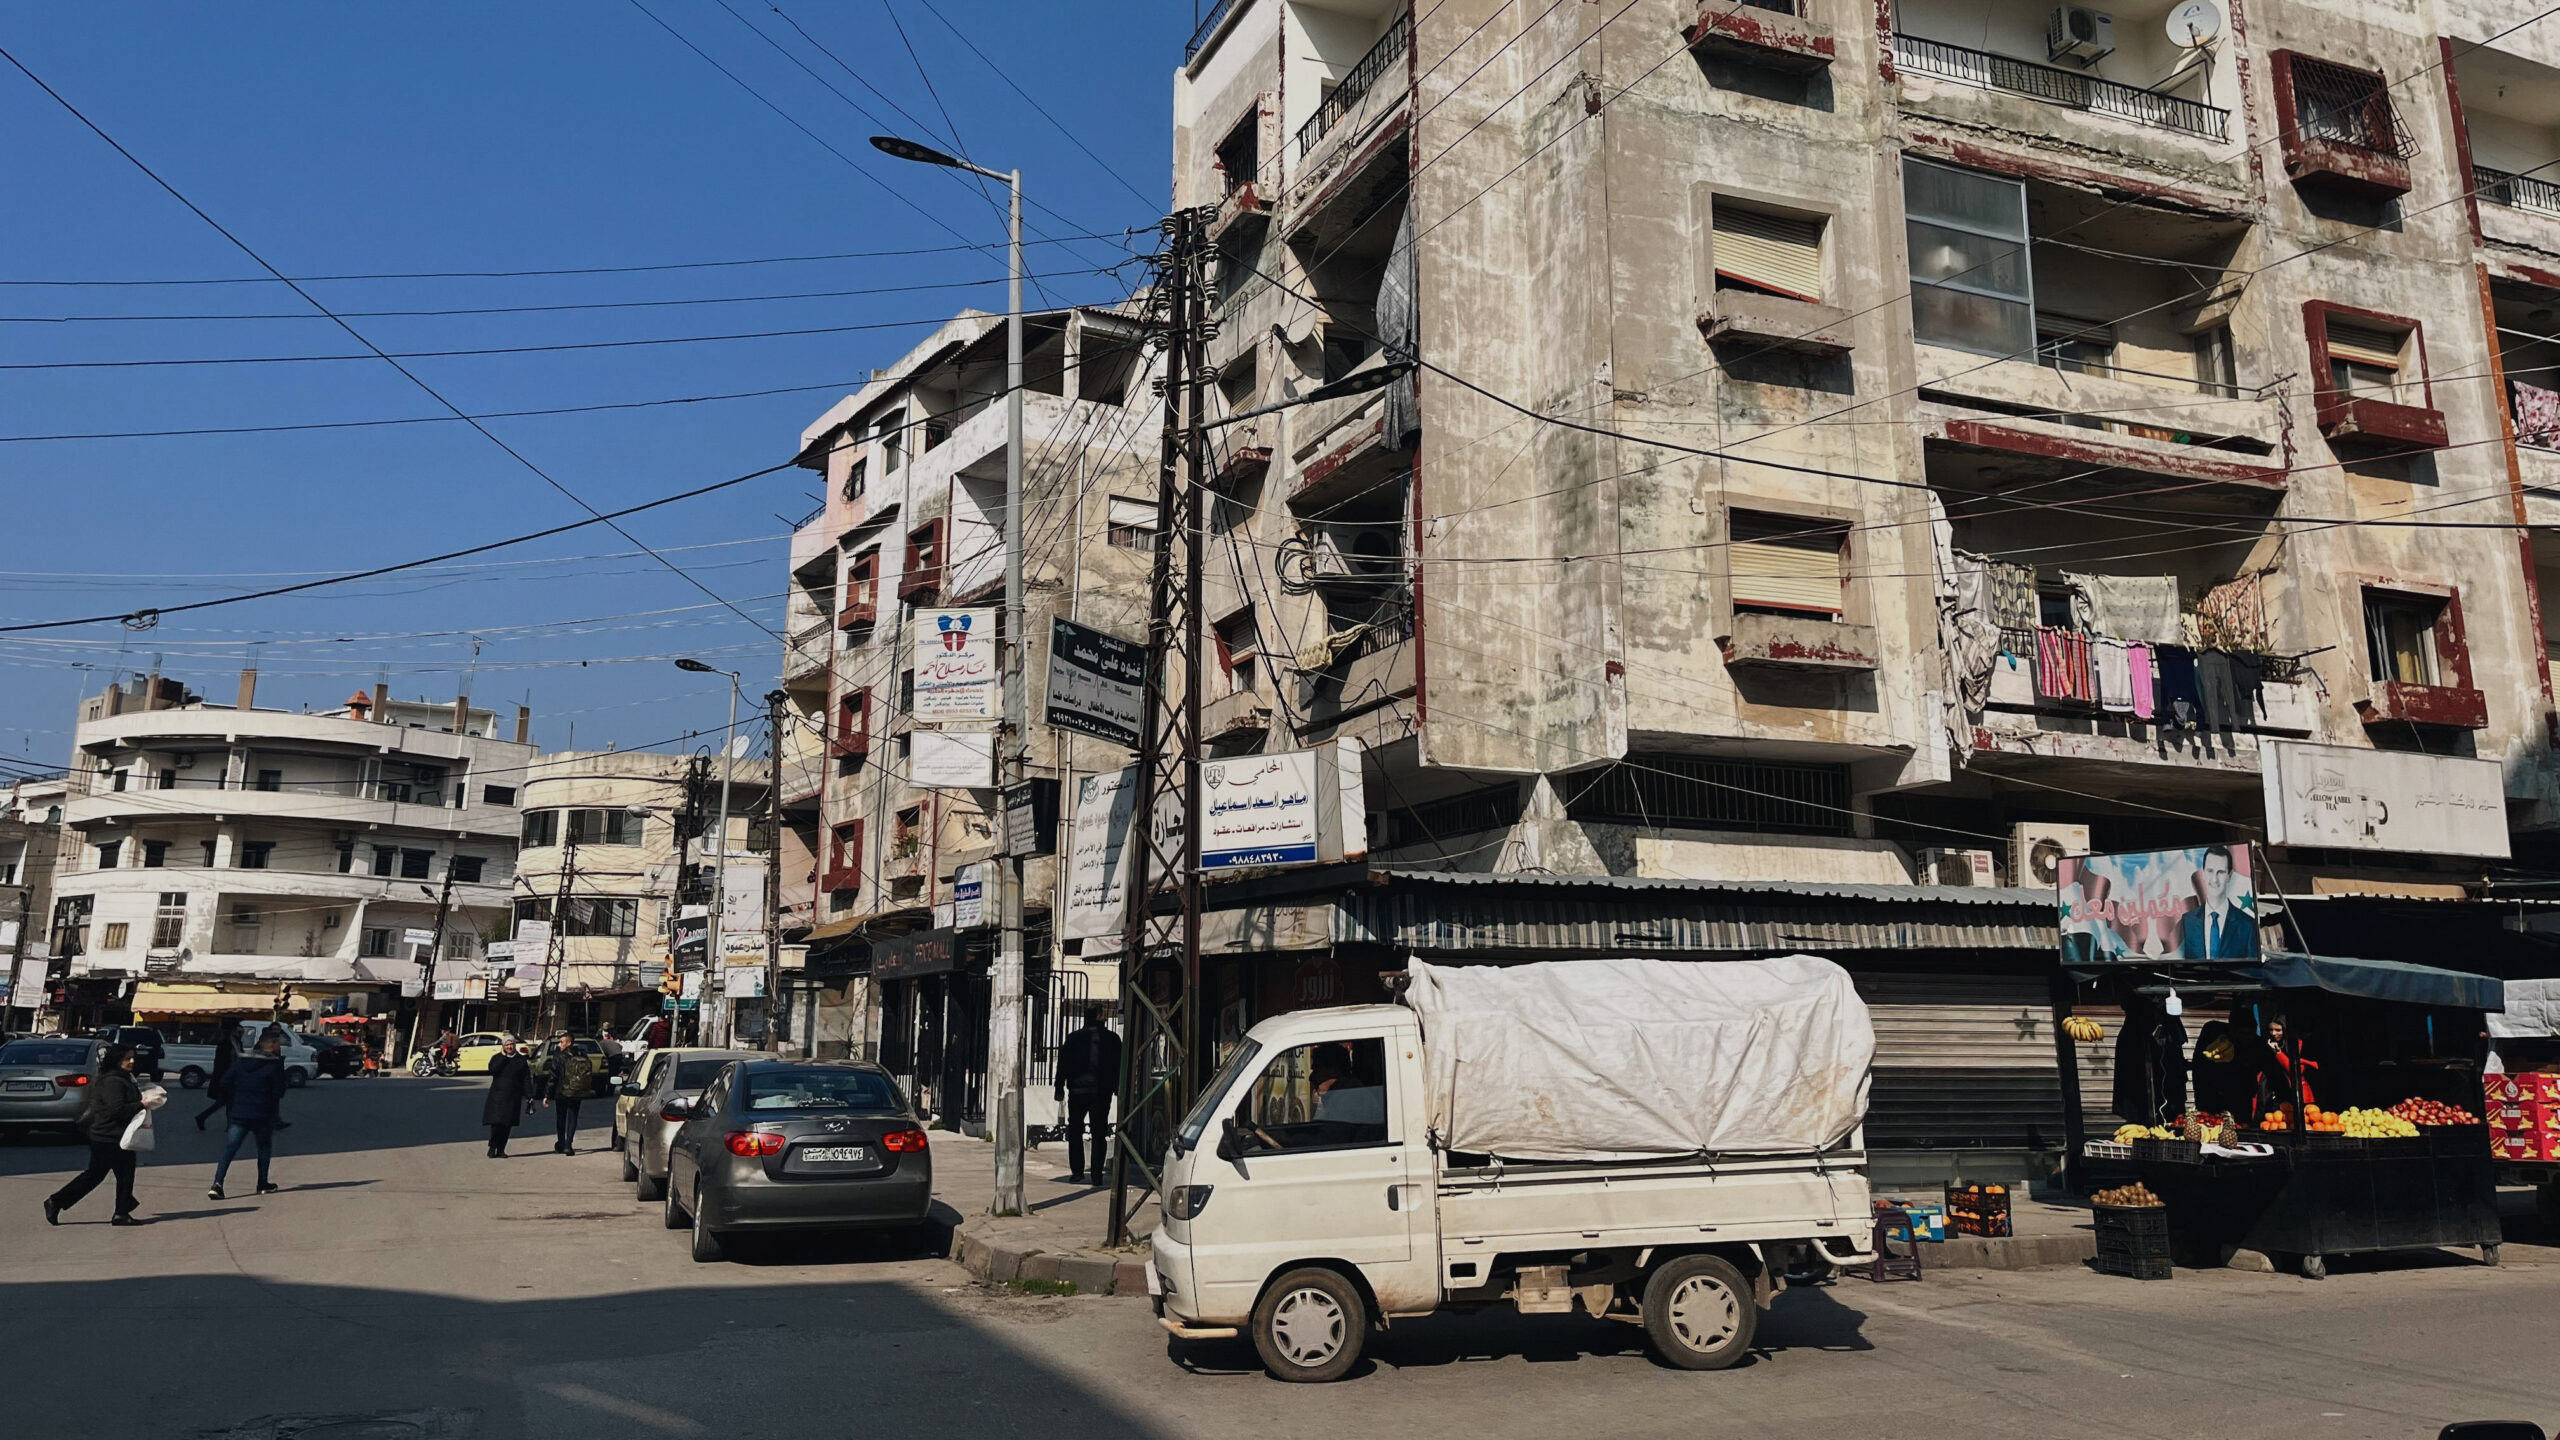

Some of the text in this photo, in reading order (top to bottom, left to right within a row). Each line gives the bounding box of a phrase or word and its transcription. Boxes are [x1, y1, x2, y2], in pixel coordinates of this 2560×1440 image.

[1073, 644, 1099, 664] محمد
[1099, 637, 1126, 653] الدكتورة
[1227, 759, 1283, 786] المحامي
[1101, 777, 1134, 796] الدكتور
[2325, 802, 2338, 811] TEA
[2334, 795, 2352, 805] LABEL
[1212, 819, 1303, 837] استشارات مرافعات عقود
[2070, 885, 2116, 924] معك
